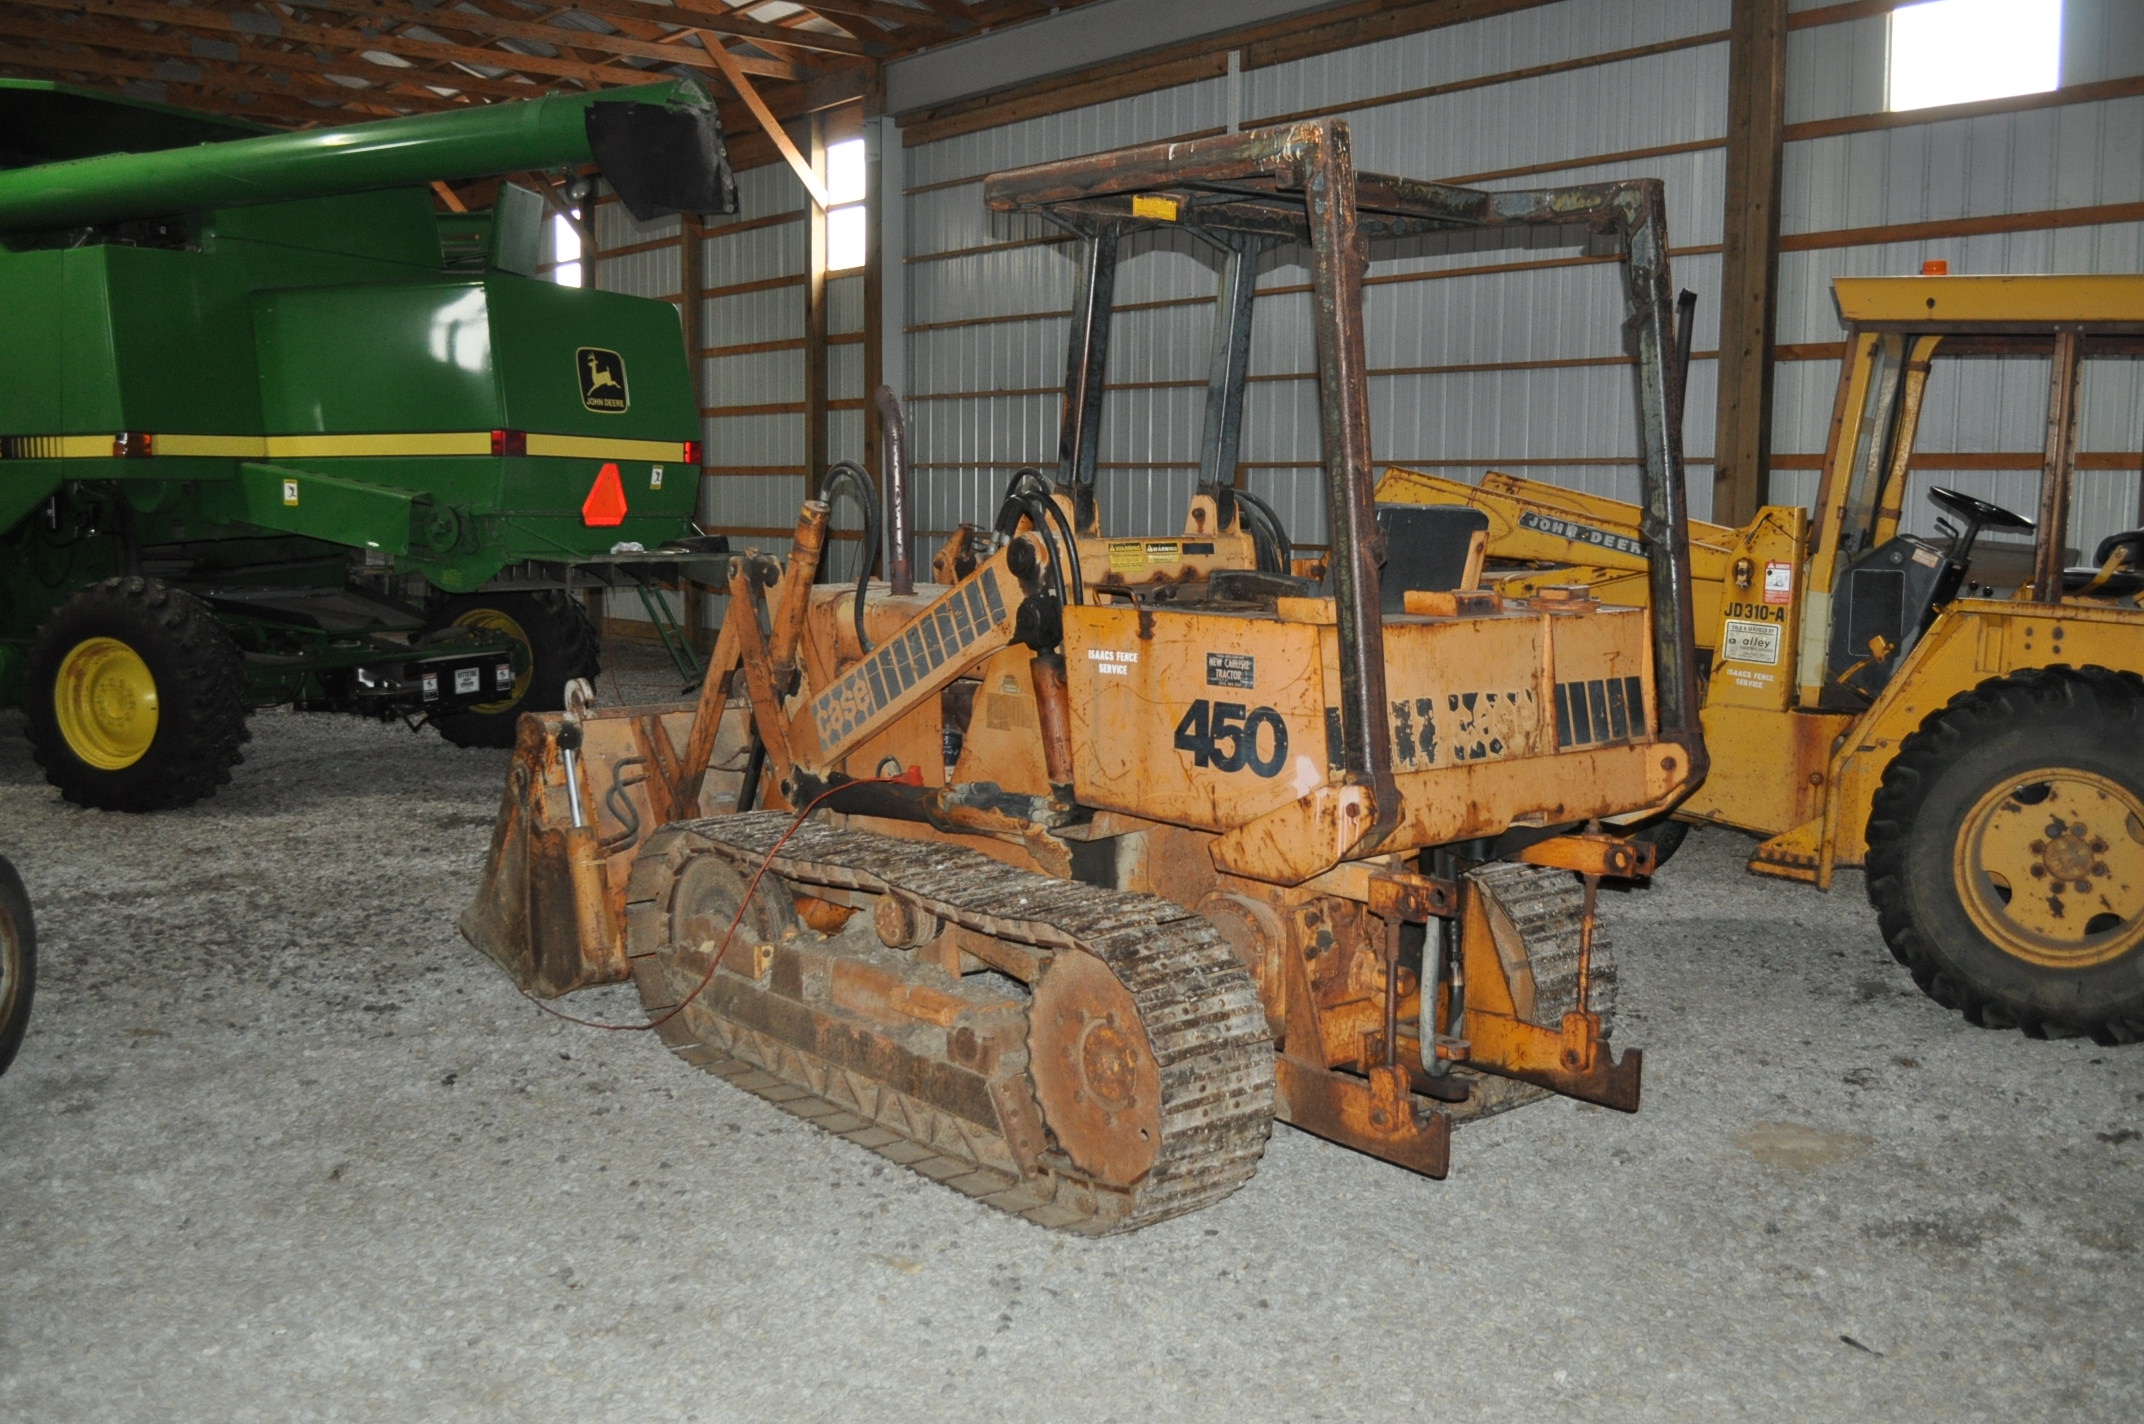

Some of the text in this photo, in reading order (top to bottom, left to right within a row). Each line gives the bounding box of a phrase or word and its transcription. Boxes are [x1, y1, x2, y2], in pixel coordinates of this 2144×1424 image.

[586, 397, 624, 407] JOHN DEERE
[1528, 516, 1649, 556] JOHN DEER
[1742, 637, 1771, 648] alley
[1088, 649, 1138, 663] ISAACS FENCE
[1208, 656, 1223, 667] NEW
[1099, 663, 1127, 675] SERVICE
[1215, 668, 1243, 680] TRACTOR
[1727, 669, 1775, 682] ISAACS FENCE
[1735, 678, 1763, 689] SERVICE
[1173, 698, 1289, 778] 450
